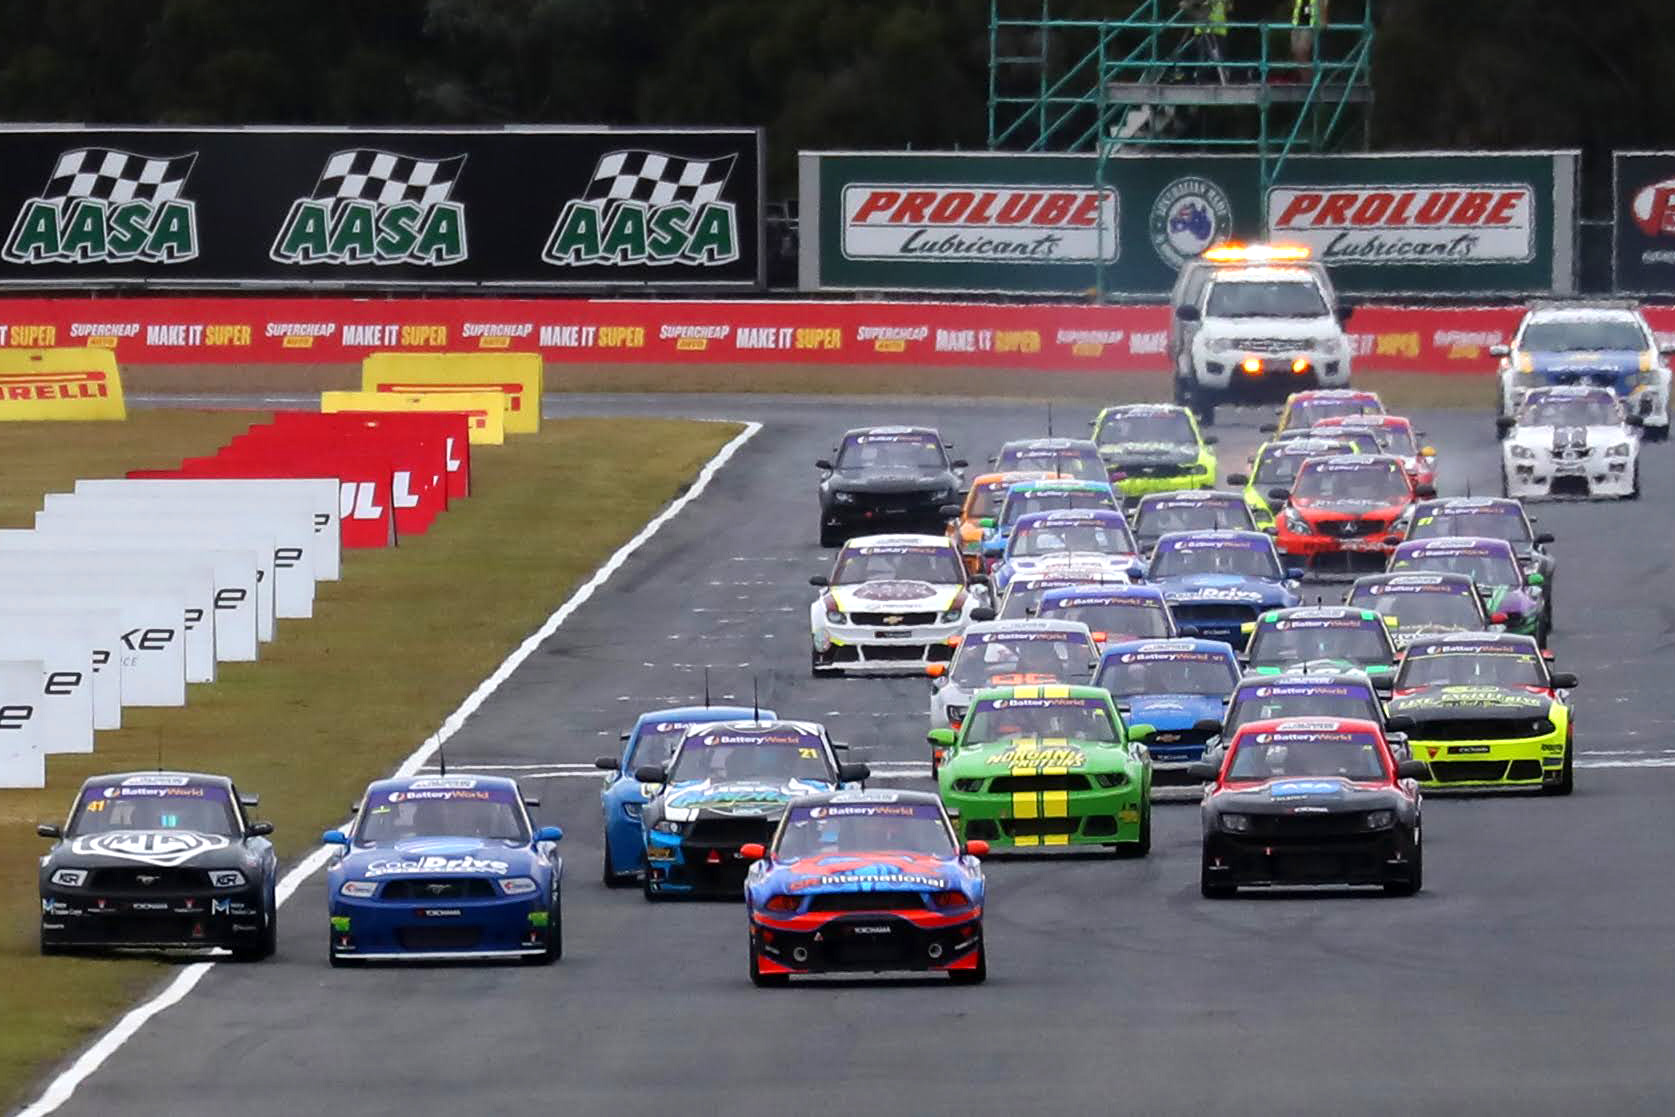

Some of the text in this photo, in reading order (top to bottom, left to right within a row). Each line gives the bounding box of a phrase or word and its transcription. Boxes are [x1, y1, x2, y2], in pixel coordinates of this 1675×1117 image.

[852, 191, 1110, 226] PROLUBE
[1274, 192, 1526, 227] PROLUBE
[2, 198, 199, 264] AASA
[270, 198, 469, 265] AASA
[542, 199, 739, 266] AASA
[899, 229, 1062, 257] Lubricants
[1322, 232, 1480, 258] Lubricants
[10, 325, 55, 346] SUPER
[70, 323, 140, 337] SUPERCHEAP
[147, 325, 252, 346] MAKE IT SUPER
[265, 323, 336, 337] SUPERCHEAP
[342, 325, 447, 346] MAKE IT SUPER
[462, 323, 533, 337] SUPERCHEAP
[539, 326, 645, 346] MAKE IT SUPER
[659, 325, 730, 339] SUPERCHEAP
[736, 328, 842, 349] MAKE IT SUPER
[1290, 620, 1361, 629] BatteryWorld
[1136, 652, 1208, 661] BatteryWorld
[1273, 687, 1348, 696] BatteryWorld
[1009, 699, 1086, 708] BatteryWorld
[721, 735, 800, 745] BatteryWorld
[1273, 734, 1353, 742] BatteryWorld
[799, 748, 819, 759] 21
[121, 787, 204, 798] BatteryWorld
[406, 791, 489, 801] BatteryWorld
[828, 806, 914, 817] BatteryWorld
[822, 873, 944, 888] International
